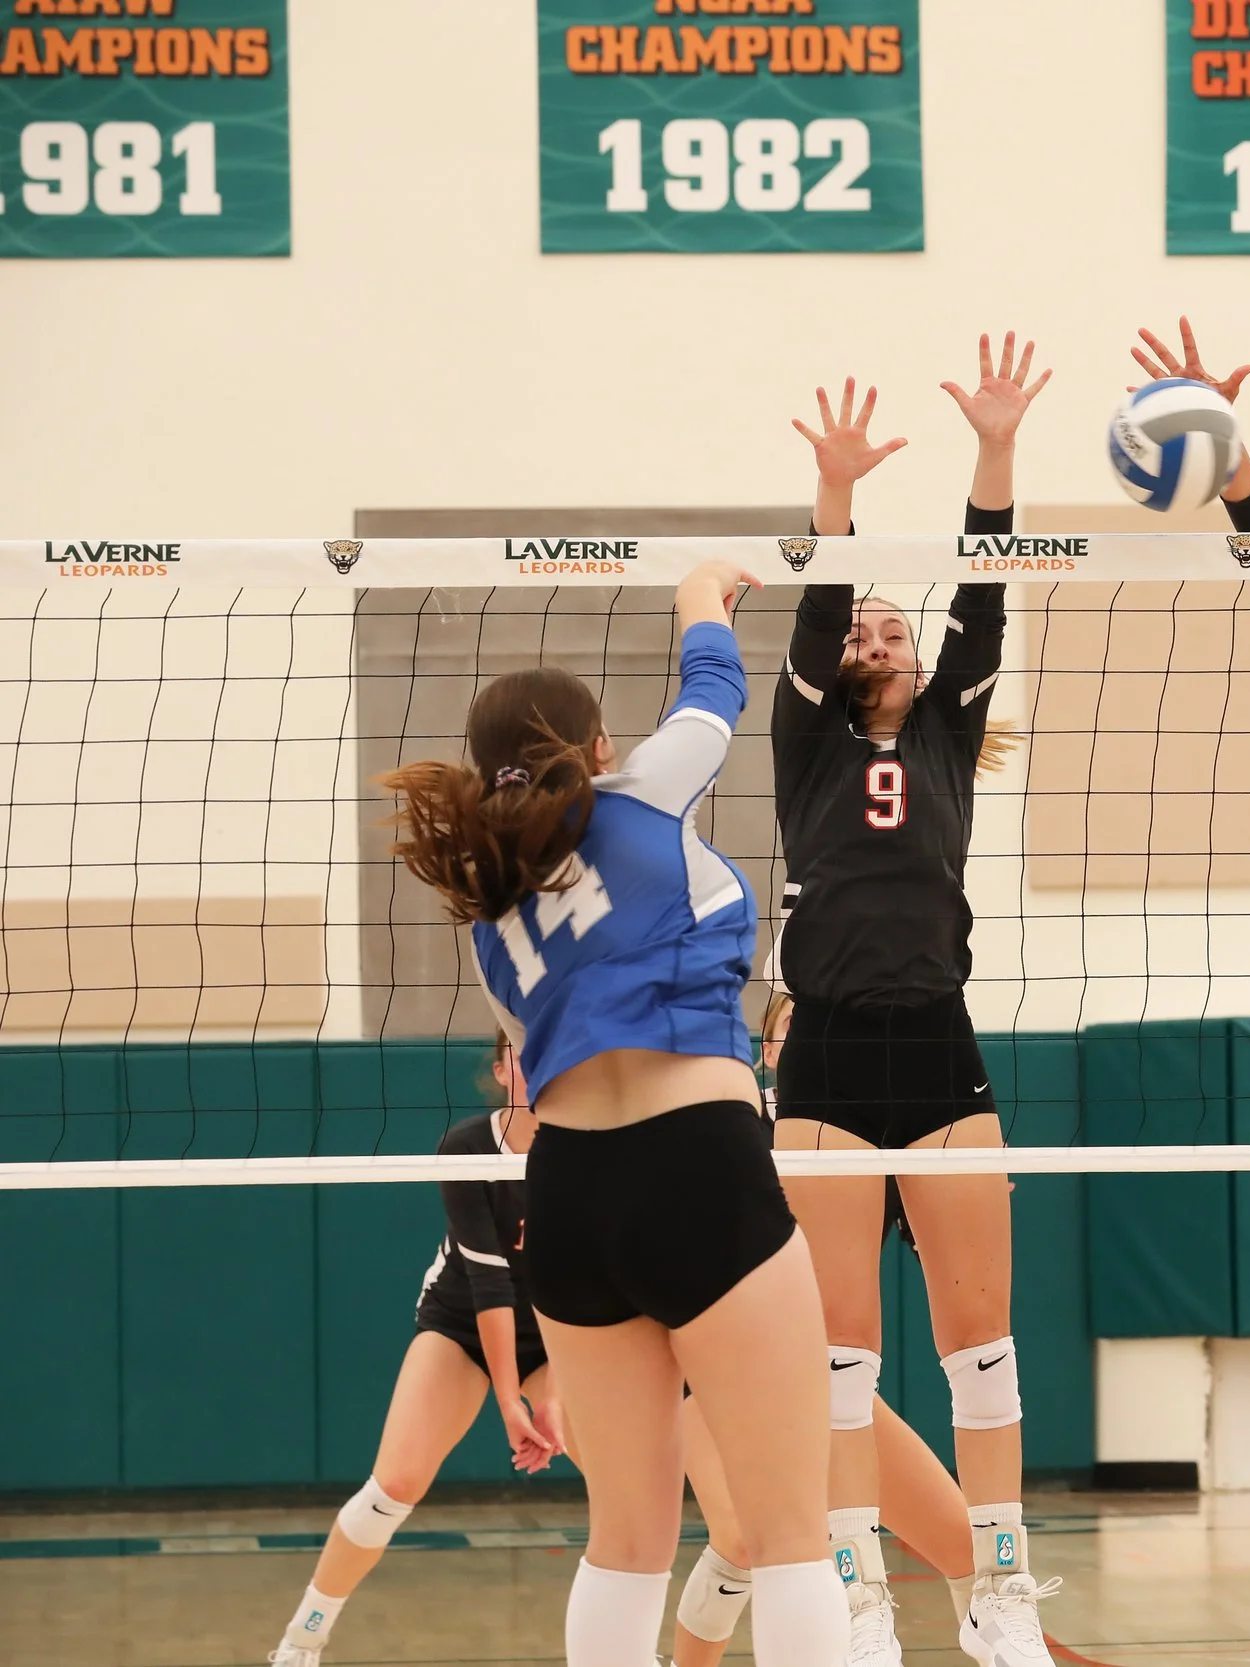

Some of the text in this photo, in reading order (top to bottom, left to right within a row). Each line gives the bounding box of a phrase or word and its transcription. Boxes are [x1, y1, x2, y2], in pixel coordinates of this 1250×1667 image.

[0, 27, 269, 75] AMPIONS
[566, 25, 902, 74] CHAMPIONS
[0, 121, 222, 215] 981
[599, 118, 872, 212] 1982
[59, 564, 168, 577] LEOPARDS
[519, 561, 625, 574] LEOPARDS
[971, 558, 1076, 571] LEOPARDS
[865, 760, 907, 830] 9
[496, 851, 613, 999] 14
